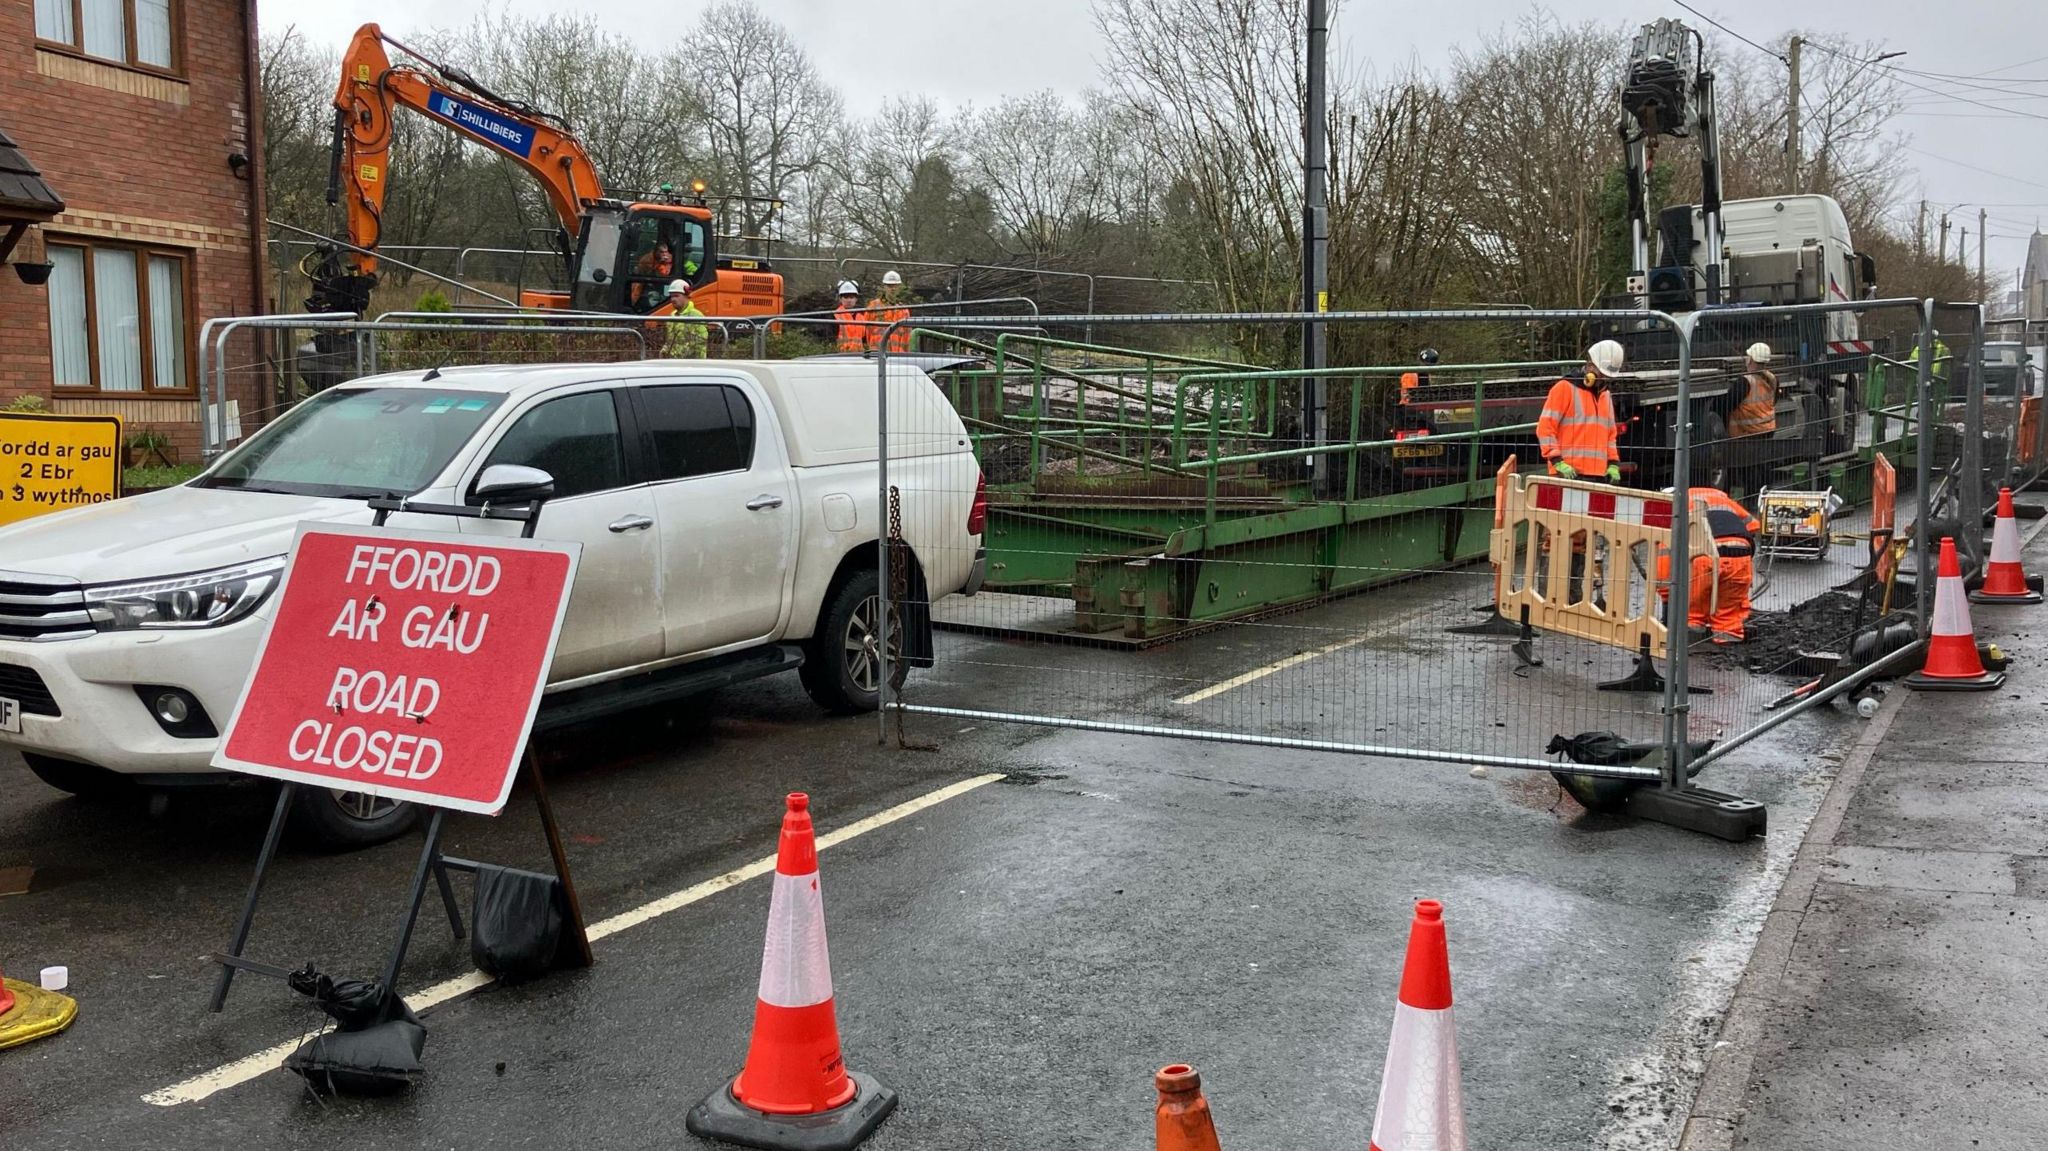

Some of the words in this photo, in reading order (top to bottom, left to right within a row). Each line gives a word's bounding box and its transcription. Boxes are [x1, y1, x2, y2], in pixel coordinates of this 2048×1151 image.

[461, 109, 522, 144] SHILLIBIERS
[56, 445, 74, 458] ar
[81, 446, 112, 461] gau
[20, 463, 33, 479] 2
[41, 463, 75, 480] Ebr
[12, 486, 25, 502] 3
[33, 487, 113, 505] wythnos
[345, 545, 501, 597] FFORDD
[328, 599, 387, 642] AR
[401, 605, 490, 654] GAU
[326, 667, 441, 720] ROAD
[0, 700, 13, 726] F
[288, 719, 443, 781] CLOSED
